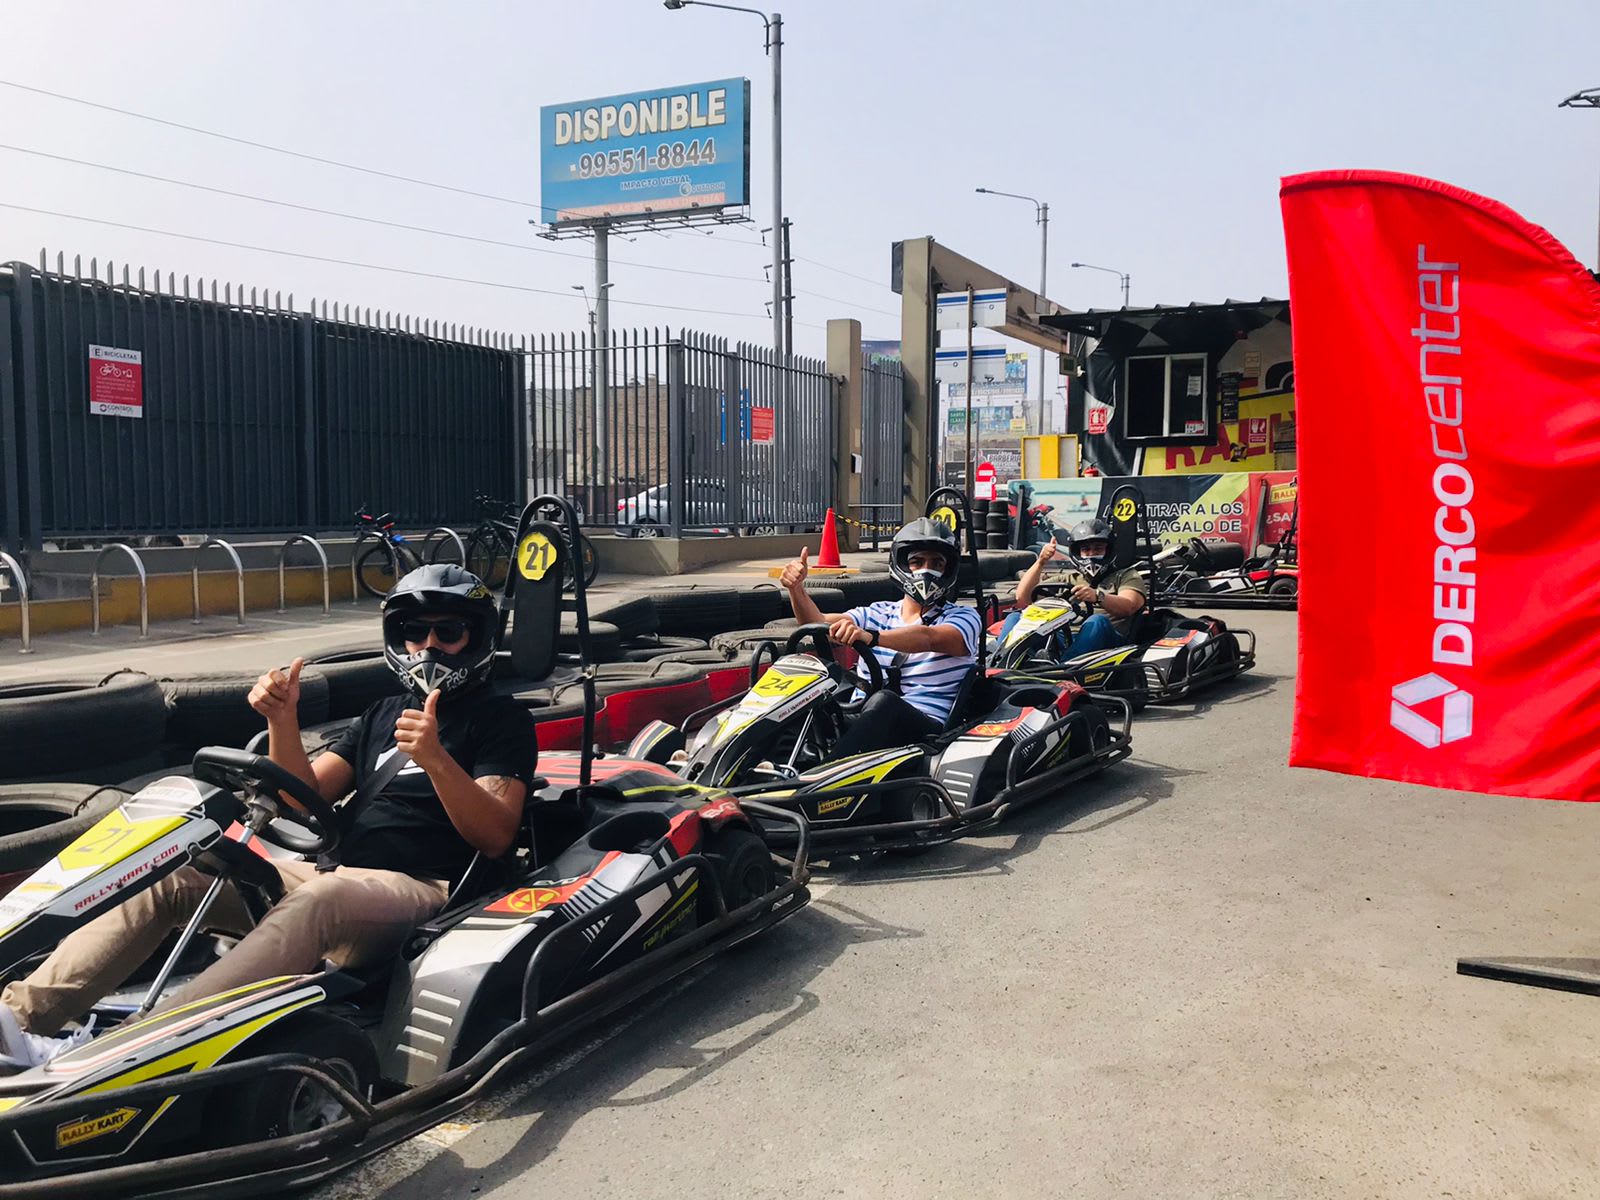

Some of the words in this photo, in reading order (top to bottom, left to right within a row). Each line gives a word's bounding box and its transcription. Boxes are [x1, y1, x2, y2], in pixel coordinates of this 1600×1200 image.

[554, 87, 727, 147] DISPONIBLE
[579, 137, 715, 179] 99551-8844
[620, 178, 659, 191] IMPACTO
[660, 174, 690, 186] VISUAL
[1117, 503, 1133, 516] 22
[1195, 502, 1206, 516] A
[1210, 502, 1243, 516] LOS
[1148, 519, 1214, 534] HAGALO
[1219, 519, 1242, 533] DE
[525, 541, 549, 570] 21
[759, 677, 794, 692] 24
[61, 1123, 96, 1142] RALLY
[97, 1112, 128, 1130] KART
